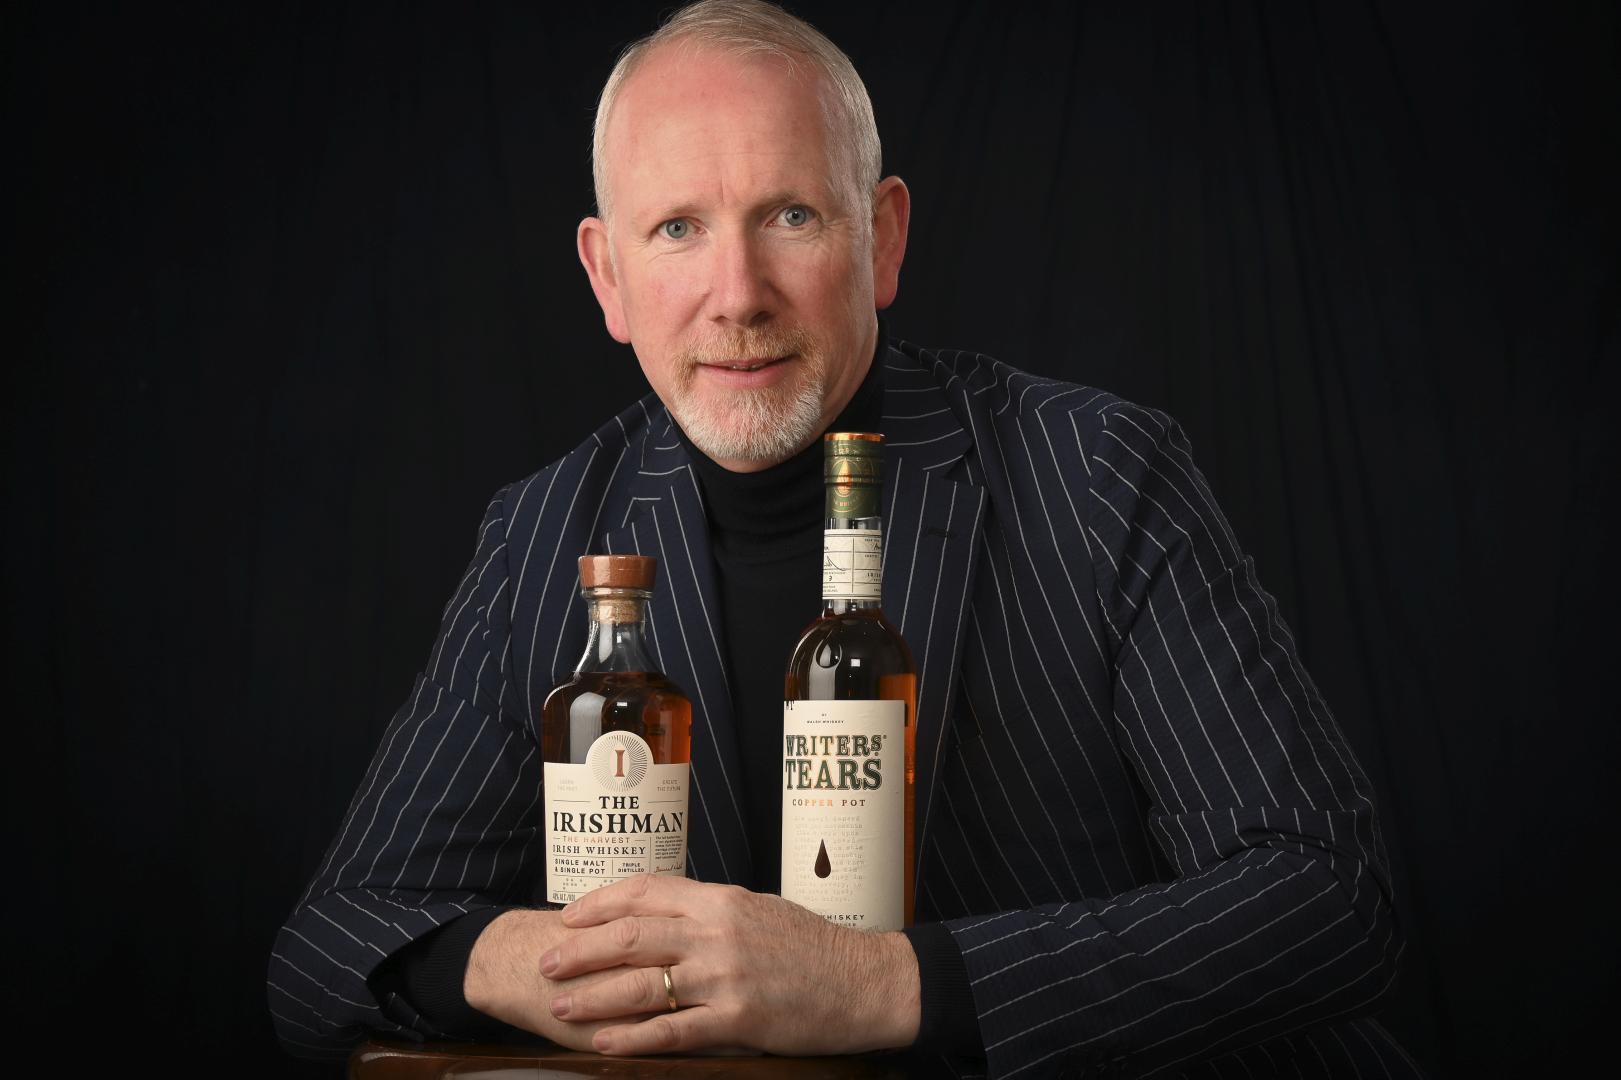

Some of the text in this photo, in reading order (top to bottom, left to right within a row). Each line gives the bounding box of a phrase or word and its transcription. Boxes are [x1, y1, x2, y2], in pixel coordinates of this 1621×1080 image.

[785, 758, 883, 791] TEARS
[598, 795, 640, 810] THE
[792, 798, 866, 807] COPPER POT
[552, 810, 685, 834] IRISHMAN
[563, 835, 631, 844] THE HARVEST
[552, 844, 646, 855] IRISH WHISKEY
[554, 858, 579, 866] SINGLE
